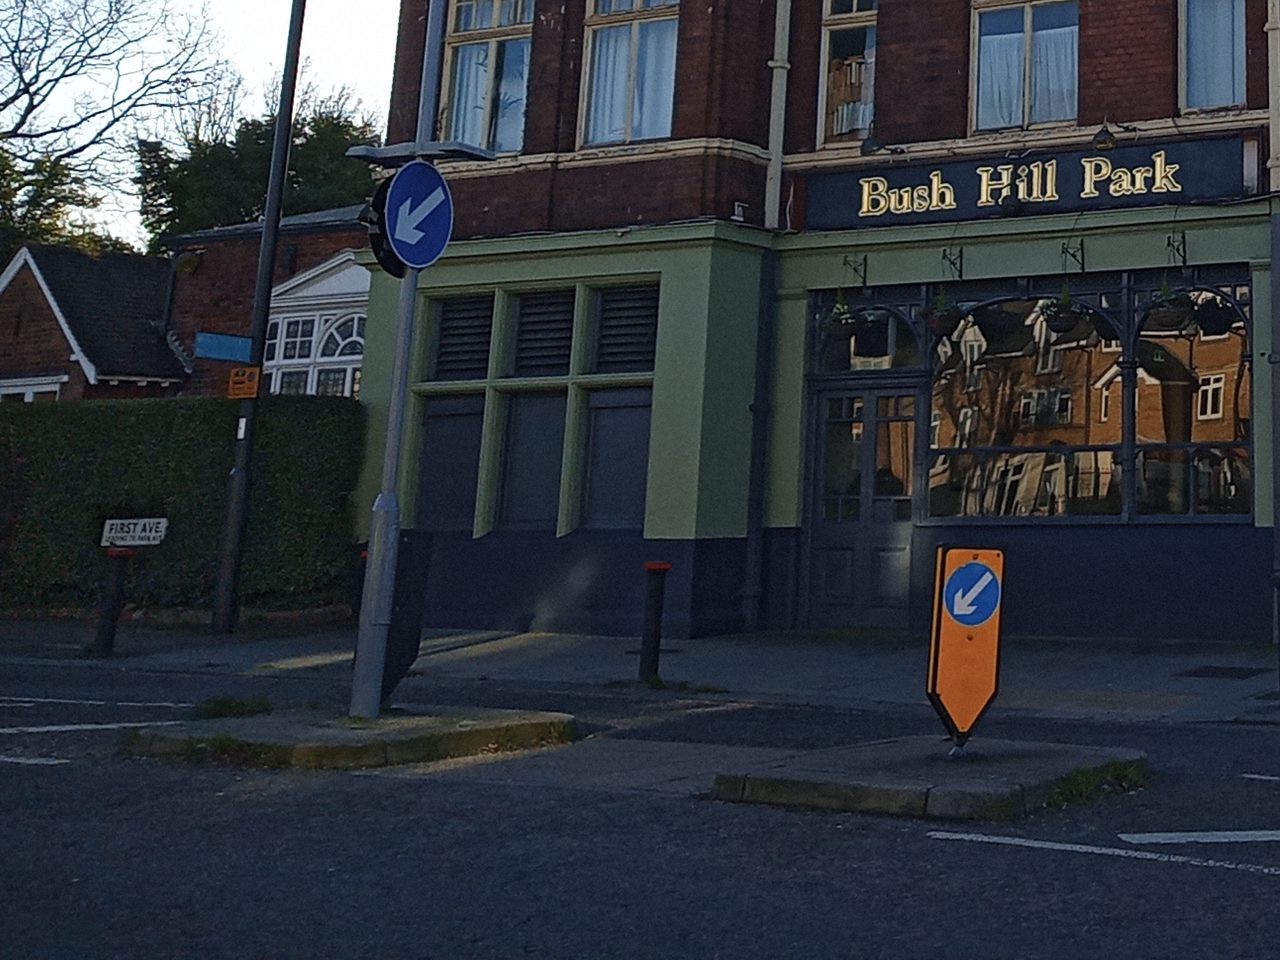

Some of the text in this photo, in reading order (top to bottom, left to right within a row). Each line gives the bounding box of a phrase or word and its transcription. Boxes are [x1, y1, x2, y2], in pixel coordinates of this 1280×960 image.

[858, 150, 1182, 217] Bush Hill Park
[109, 522, 139, 534] FIRST
